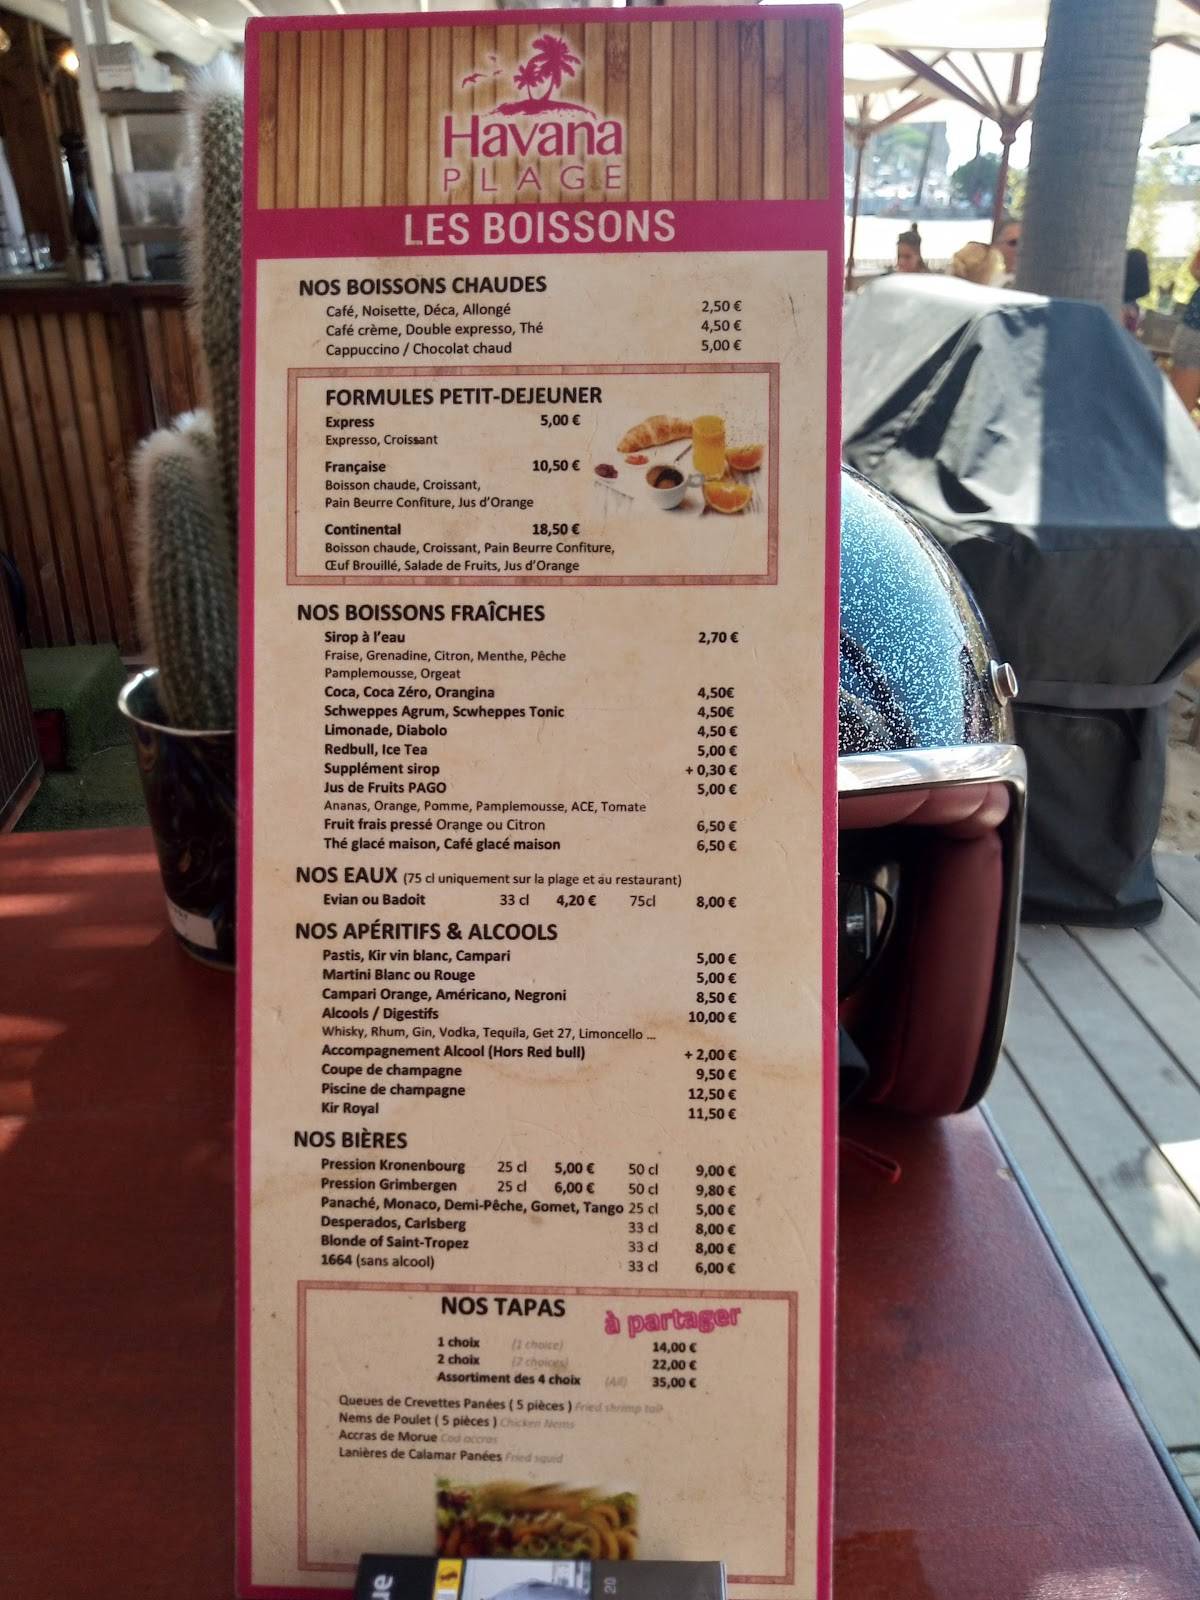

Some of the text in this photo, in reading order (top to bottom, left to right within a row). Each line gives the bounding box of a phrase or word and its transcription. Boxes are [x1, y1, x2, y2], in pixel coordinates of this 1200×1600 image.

[444, 115, 623, 158] Havana
[443, 164, 622, 192] PLAGE
[405, 208, 676, 246] LES BOISSONS
[299, 275, 547, 296] NOS BOISSONS CHAUDES
[326, 302, 511, 319] Café, Noisette, Déca, Allongé
[701, 300, 742, 314] 2,50 €
[325, 321, 543, 337] Café crème, Double expresso, Thé
[701, 319, 741, 334] 4,50 €
[326, 343, 399, 358] Cappuccino
[413, 342, 469, 354] Chocolat
[472, 341, 512, 354] chaud
[701, 339, 741, 353] 5,00 €
[326, 387, 602, 405] FORMULES PETIT-DEJEUNER
[325, 416, 374, 430] Express
[540, 414, 580, 428] 5,00 €
[325, 434, 438, 447] Expresso, Croissant
[325, 460, 386, 475] Française
[532, 459, 580, 473] 10,50 €
[324, 523, 401, 535] Continental
[532, 523, 580, 536] 18,50 €
[297, 600, 545, 621] NOS BOISSONS FRAÎCHES
[324, 649, 566, 663] Fraise, Grenadine, Citron, Menthe, Pêche
[324, 667, 460, 681] Pamplemousse, Orgeat
[324, 685, 494, 700] Coca, Coca Zéro, Orangina
[697, 686, 734, 700] 4,50€
[324, 704, 564, 719] Schweppes Agrum, Scwheppes Tonic
[697, 705, 734, 719] 4,50€
[324, 723, 447, 737] Limonade, Diabolo
[324, 743, 427, 756] Redbull, Ice Tea
[324, 761, 440, 776] Supplément sirop
[323, 780, 446, 793] Jus de Fruits PAGO
[324, 817, 545, 833] Fruit frais pressé Orange ou Citron
[296, 866, 397, 883] NOS EAUX
[323, 893, 425, 905] Evian ou Badoit
[629, 894, 655, 907] 75cl
[295, 922, 337, 939] NOS
[342, 919, 441, 939] APÉRITIFS
[467, 923, 558, 940] ALCOOLS
[322, 949, 510, 964] Pastis, Kir vin blanc, Campari
[322, 968, 475, 983] Martini Blanc ou Rouge
[321, 987, 566, 1003] Campari Orange, Américano, Negroni
[321, 1044, 585, 1060] Accompagnement Alcool (Hors Red bull)
[321, 1063, 462, 1078] Coupe de champagne
[321, 1082, 465, 1098] Piscine de champagne
[321, 1101, 378, 1116] Kir Royal
[294, 1127, 407, 1148] NOS BIÈRES
[321, 1158, 465, 1174] Pression Kronenbourg
[695, 1164, 736, 1178] 9,00 €
[320, 1177, 457, 1193] Pression Grimbergen
[321, 1196, 624, 1216] Panaché, Monaco, Demi-Pêche, Gomet, Tango
[320, 1215, 466, 1232] Desperados, Carlsberg
[320, 1234, 469, 1251] Blonde of Saint-Tropez
[321, 1253, 434, 1270] 1664 (sans alcool)
[441, 1296, 565, 1317] NOS TAPAS
[604, 1307, 742, 1339] à partager
[447, 1336, 480, 1347] choix
[652, 1341, 696, 1354] 14,00 €
[338, 1429, 437, 1442] Accras de Morue
[338, 1447, 502, 1461] Lanières de Calamar Panées
